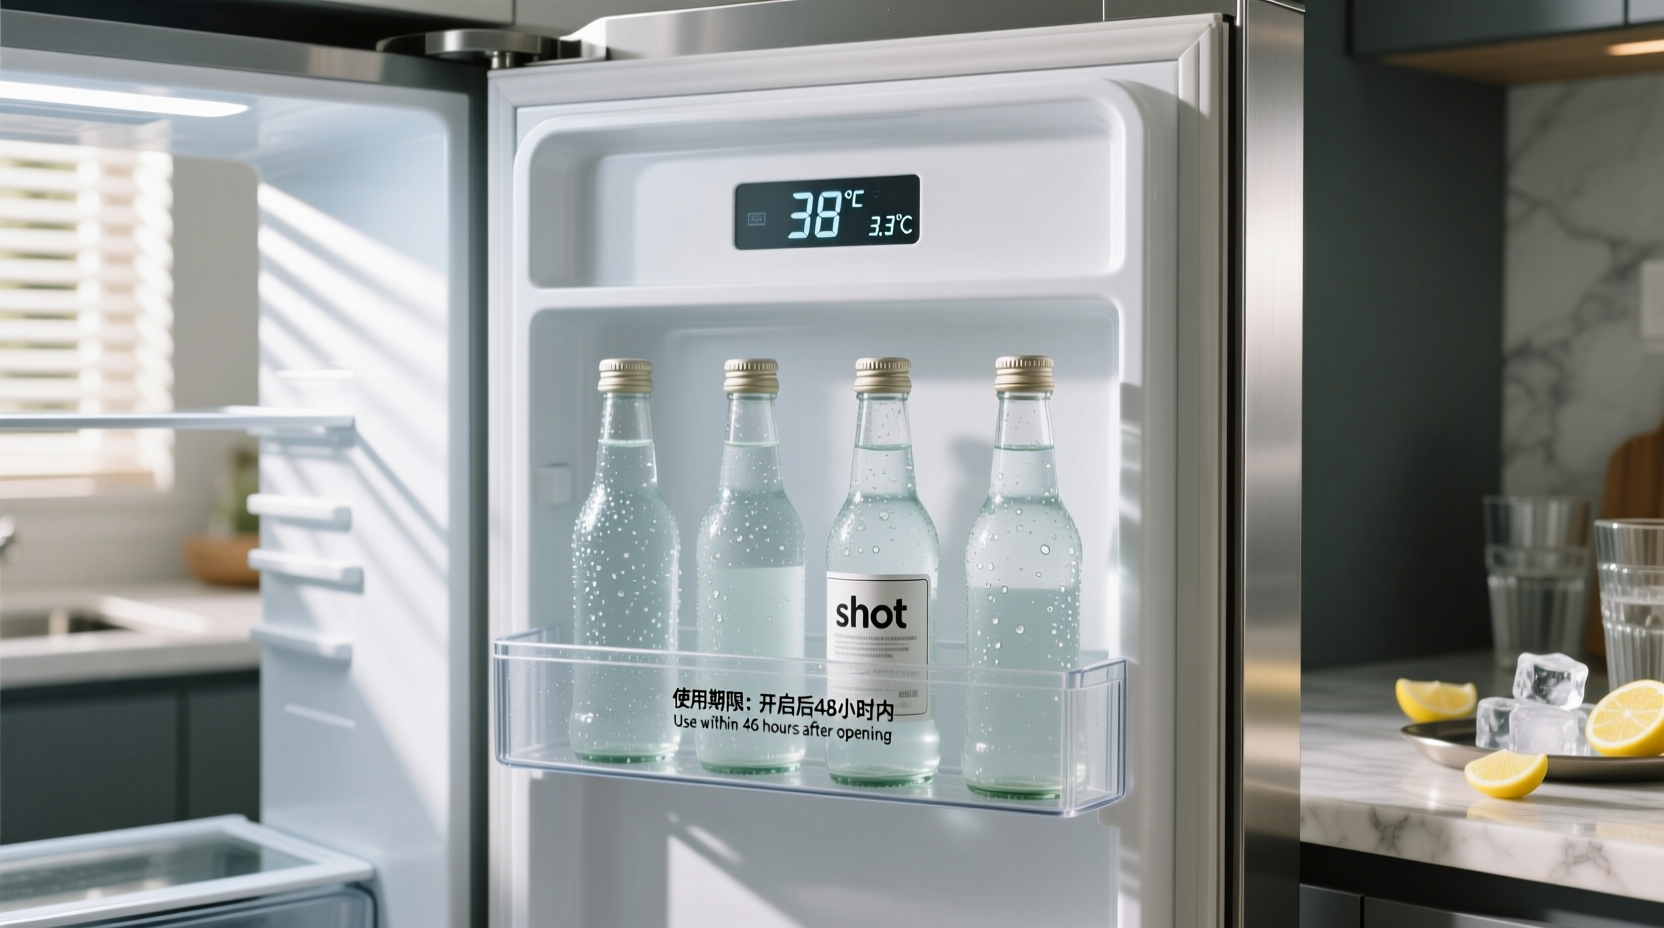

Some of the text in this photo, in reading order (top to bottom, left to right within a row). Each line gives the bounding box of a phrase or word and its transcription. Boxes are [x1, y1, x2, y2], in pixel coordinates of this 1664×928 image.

[836, 595, 908, 629] shot
[673, 714, 892, 746] Use within 46 hours after opening
